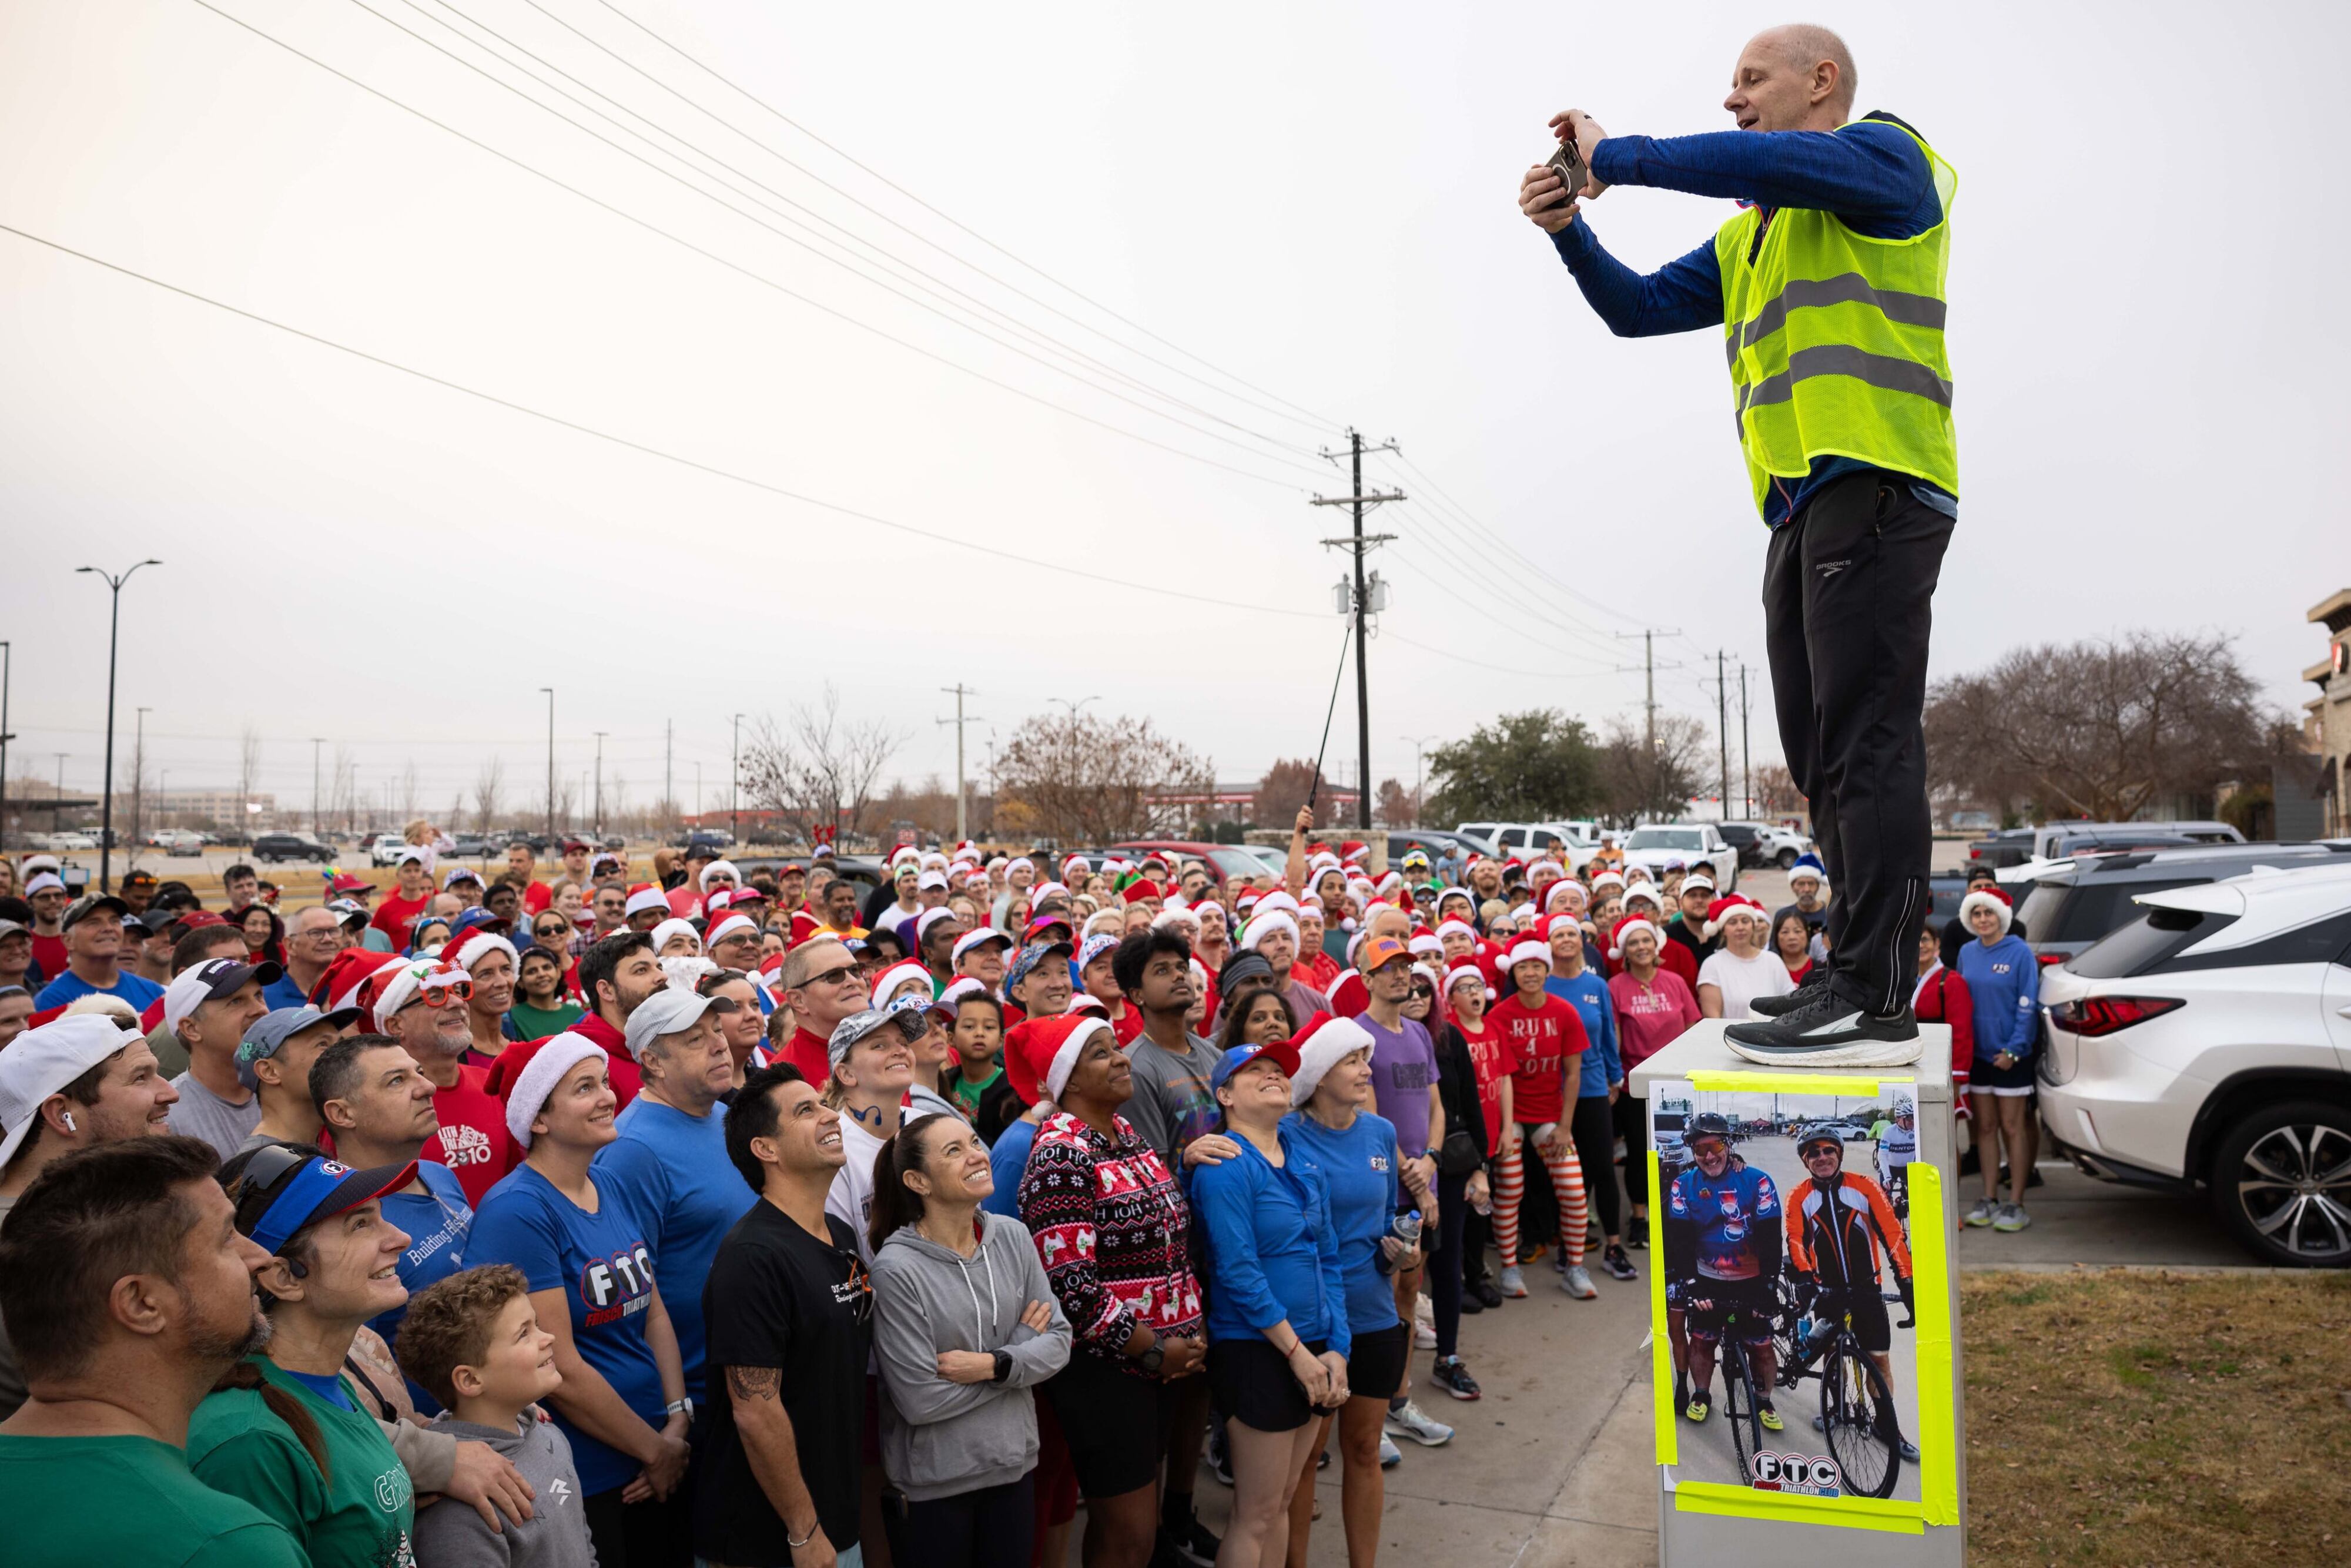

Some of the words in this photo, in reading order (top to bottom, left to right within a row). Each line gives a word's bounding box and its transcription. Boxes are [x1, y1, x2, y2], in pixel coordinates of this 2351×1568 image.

[1816, 559, 1851, 570] BROOKS
[1512, 1017, 1558, 1037] RUN
[1468, 1040, 1499, 1061] RUN
[1525, 1037, 1537, 1056] 4
[1036, 1147, 1060, 1164] HO!
[407, 1230, 453, 1267] Building
[1760, 1456, 1835, 1485] FTC
